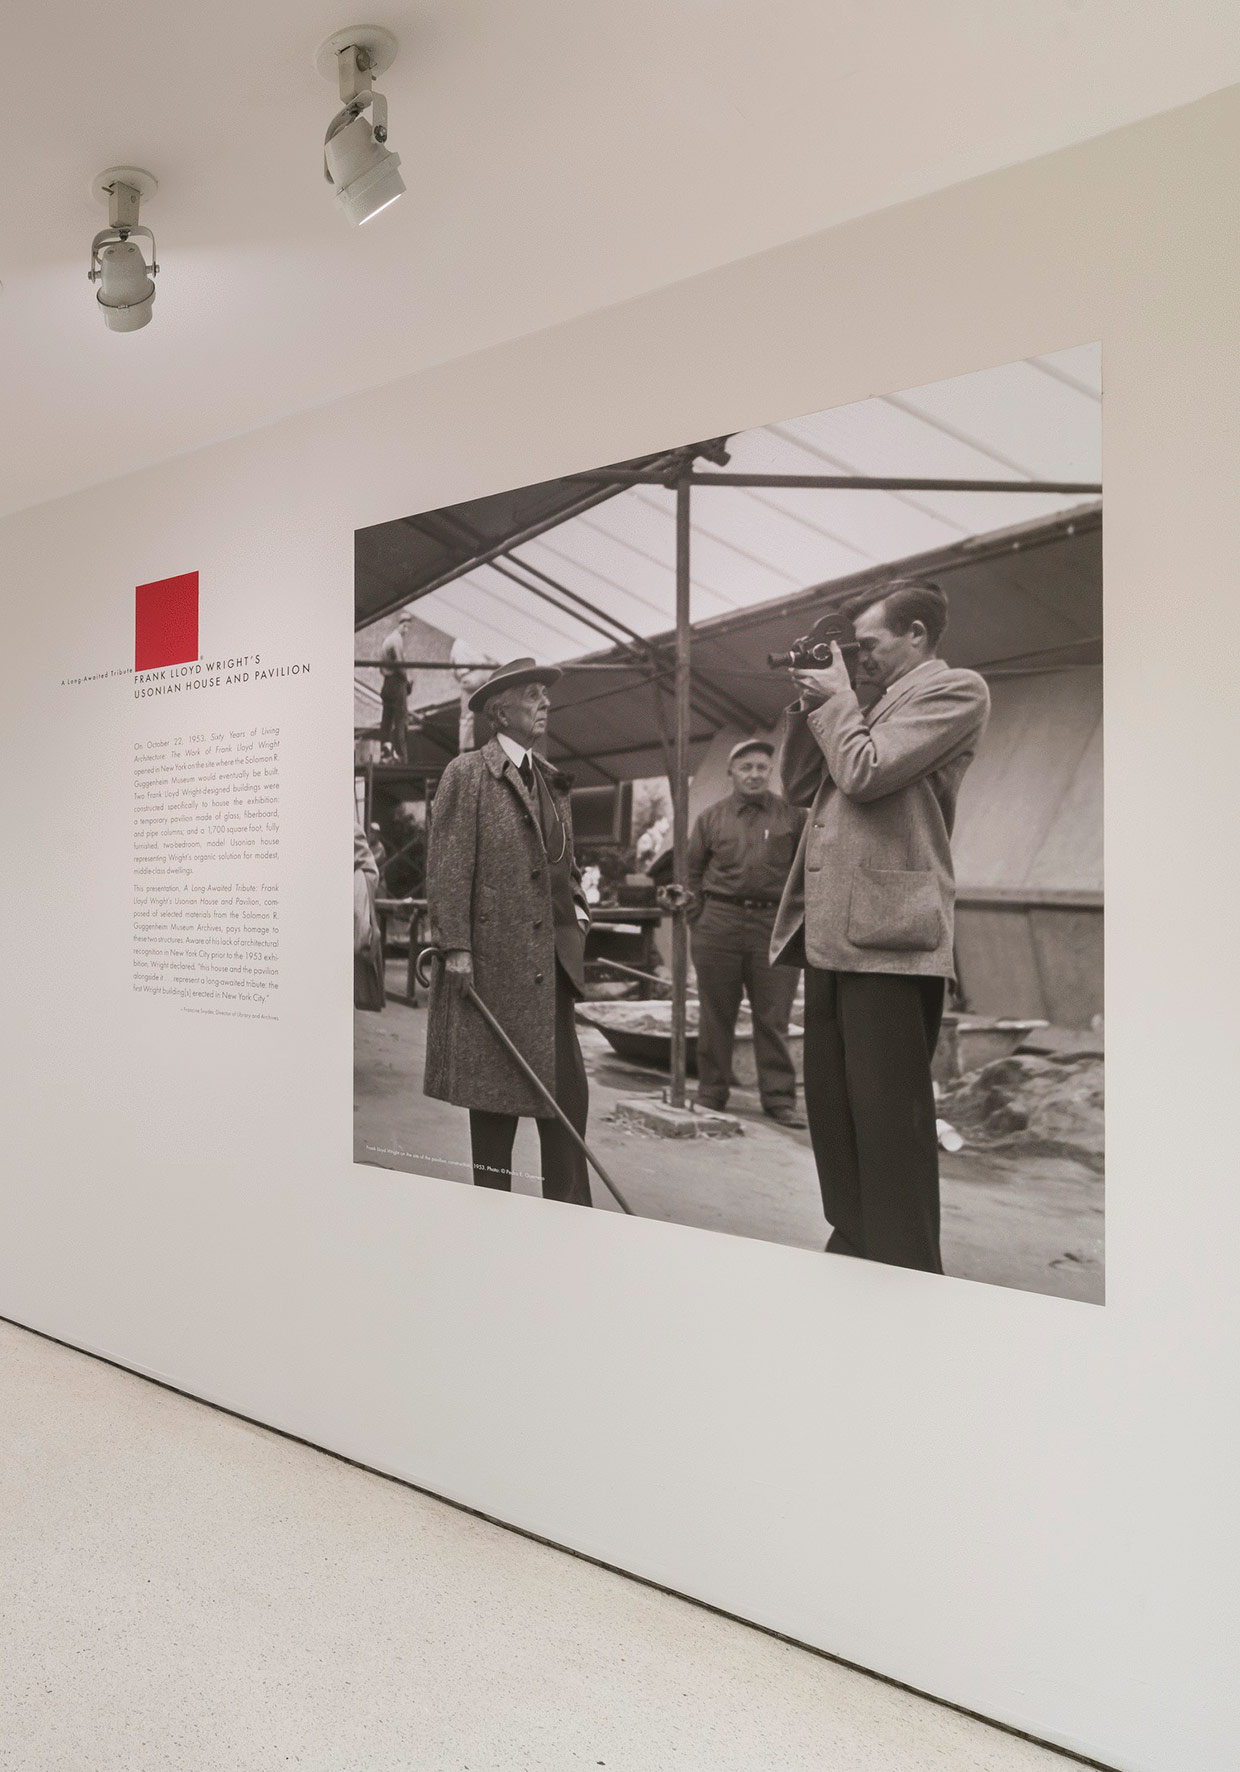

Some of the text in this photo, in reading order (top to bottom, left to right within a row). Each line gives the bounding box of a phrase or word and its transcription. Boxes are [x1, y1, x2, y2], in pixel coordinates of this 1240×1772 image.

[110, 667, 133, 677] Tribute
[134, 654, 261, 684] FRANK LLOYD WRIGHT'S
[134, 663, 312, 699] USONIAN HOUSE AND PAVILION
